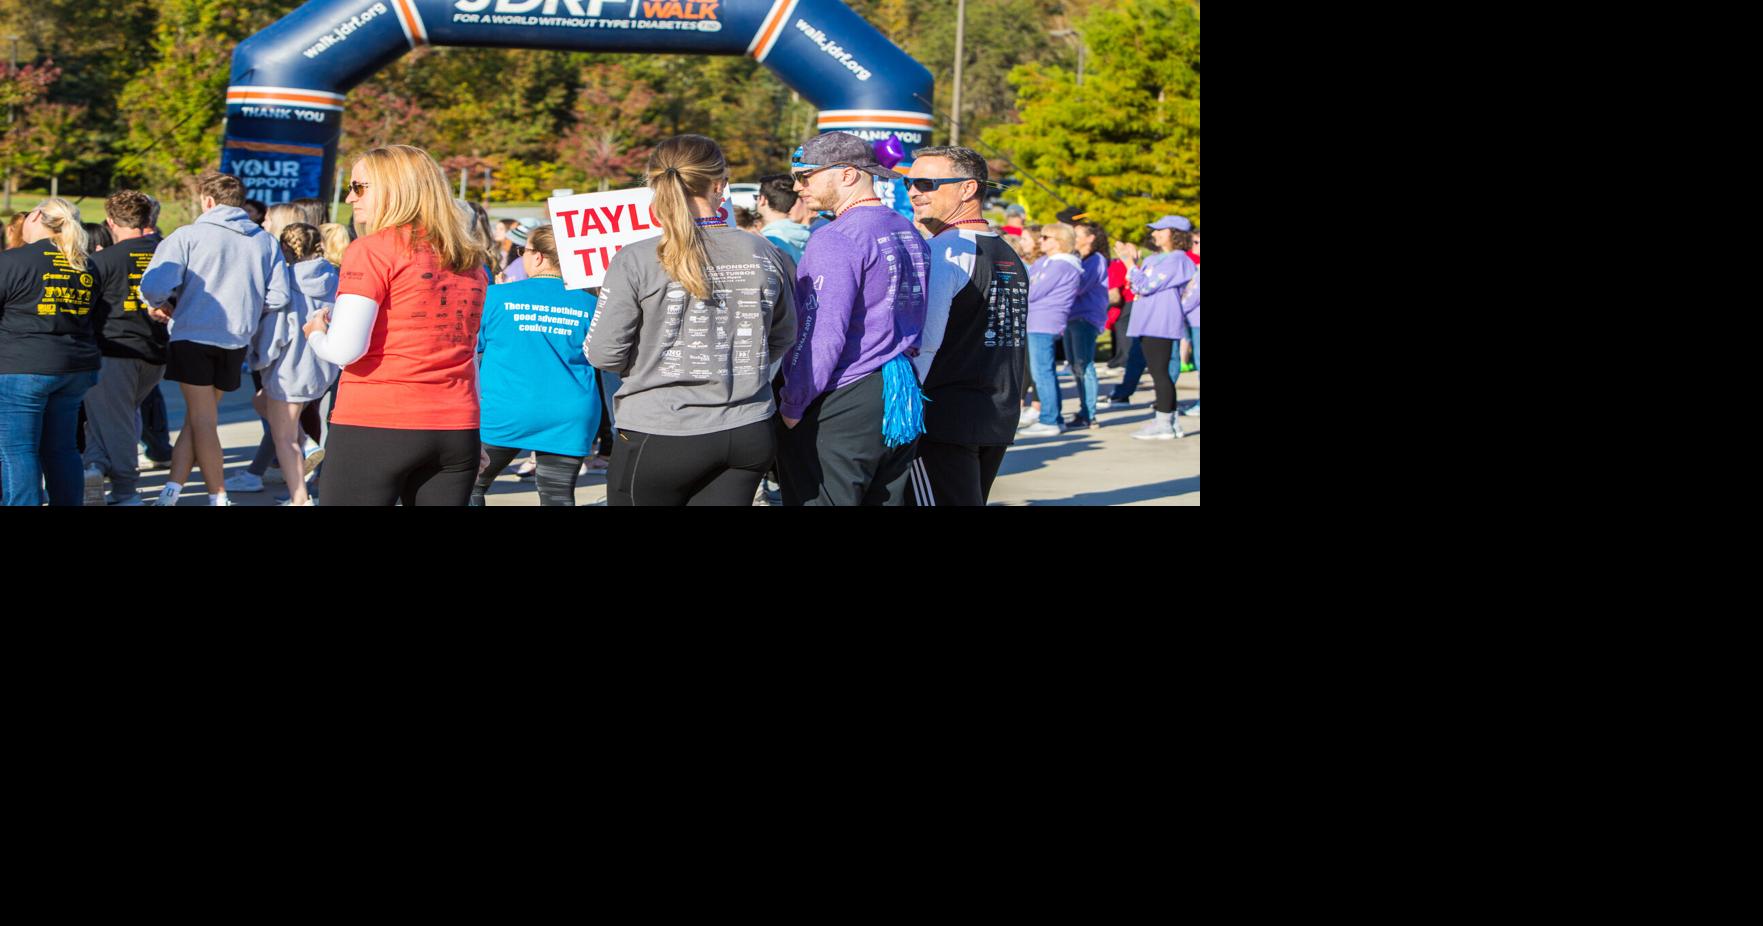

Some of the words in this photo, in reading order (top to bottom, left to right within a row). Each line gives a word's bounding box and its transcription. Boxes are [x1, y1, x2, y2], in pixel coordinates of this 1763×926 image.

[642, 1, 719, 20] WALK
[303, 2, 388, 59] walk.jdrf.org
[453, 13, 480, 23] FOR
[480, 15, 491, 24] A
[491, 15, 538, 26] WORLD
[538, 17, 598, 28] WITHOUT
[598, 19, 630, 29] TYPE
[637, 20, 698, 31] DIABETES
[795, 18, 872, 81] walk.jdrf.org
[241, 106, 292, 119] THANK
[294, 109, 326, 122] YOU
[893, 131, 922, 144] YOU
[231, 159, 300, 177] YOUR
[504, 302, 531, 311] There
[532, 304, 550, 312] was
[550, 305, 583, 318] nothing
[583, 311, 589, 319] a
[513, 313, 537, 322] good
[537, 315, 580, 327] adventure
[553, 327, 573, 336] cure
